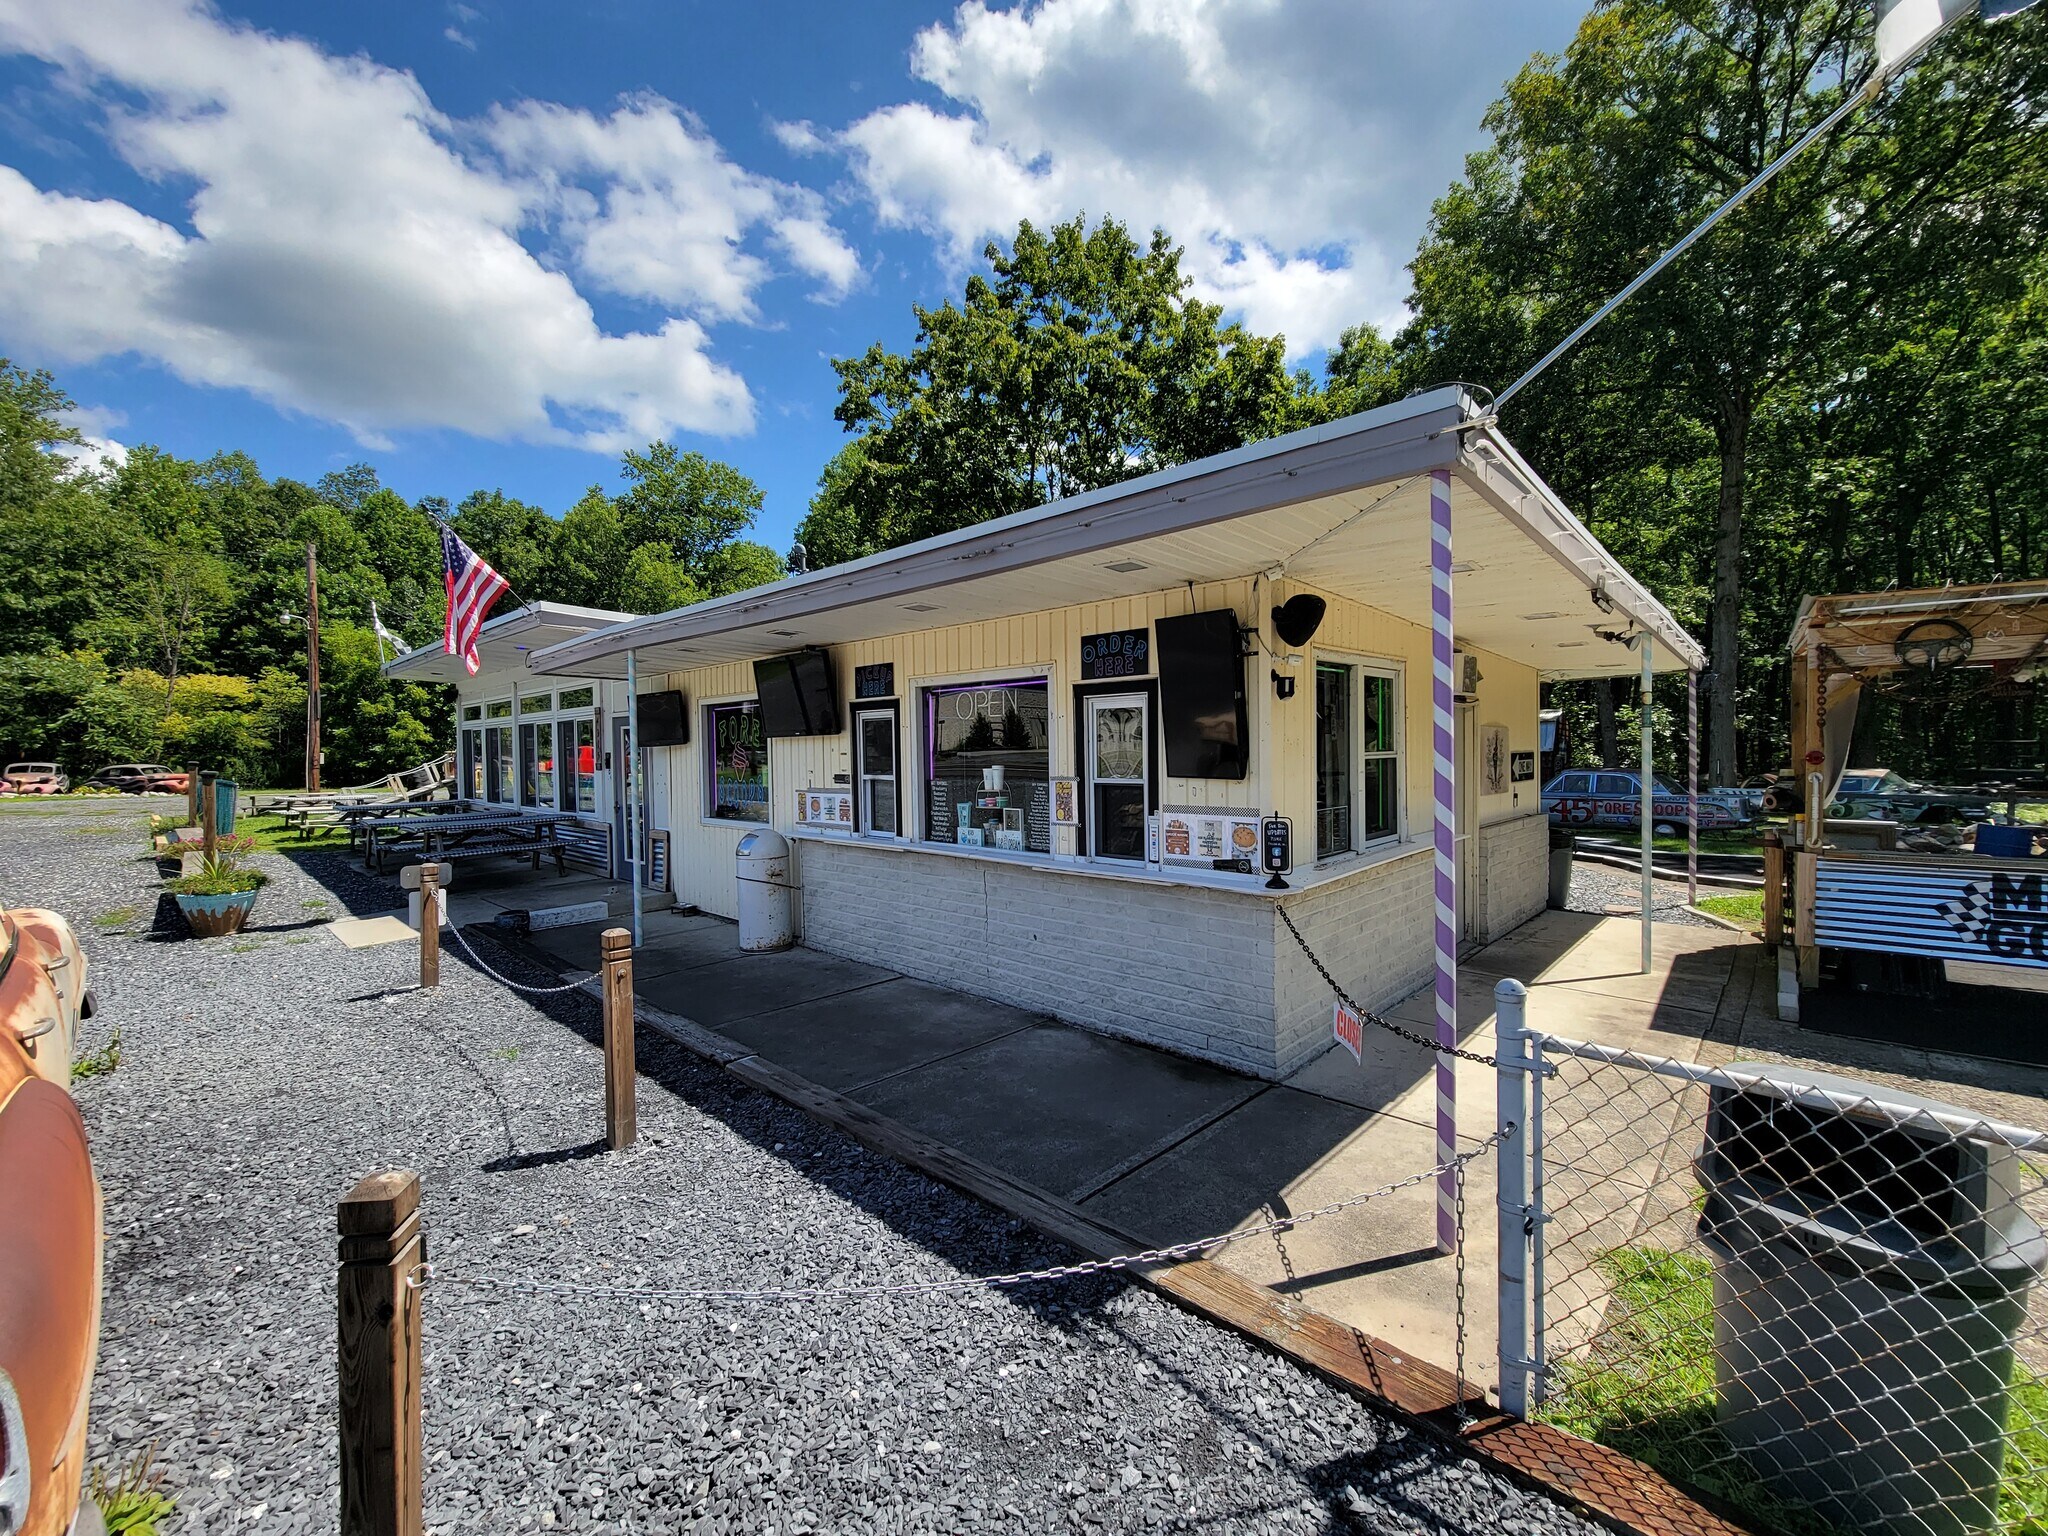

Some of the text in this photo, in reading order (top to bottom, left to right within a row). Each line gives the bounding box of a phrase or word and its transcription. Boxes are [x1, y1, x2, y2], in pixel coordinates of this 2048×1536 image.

[1082, 635, 1147, 662] ORDER
[1095, 655, 1134, 676] HERE
[862, 680, 885, 696] HERE
[956, 689, 1018, 720] OPEN
[719, 715, 760, 748] FORE
[1549, 799, 1593, 823] 45
[1594, 800, 1690, 816] FORE SOOP
